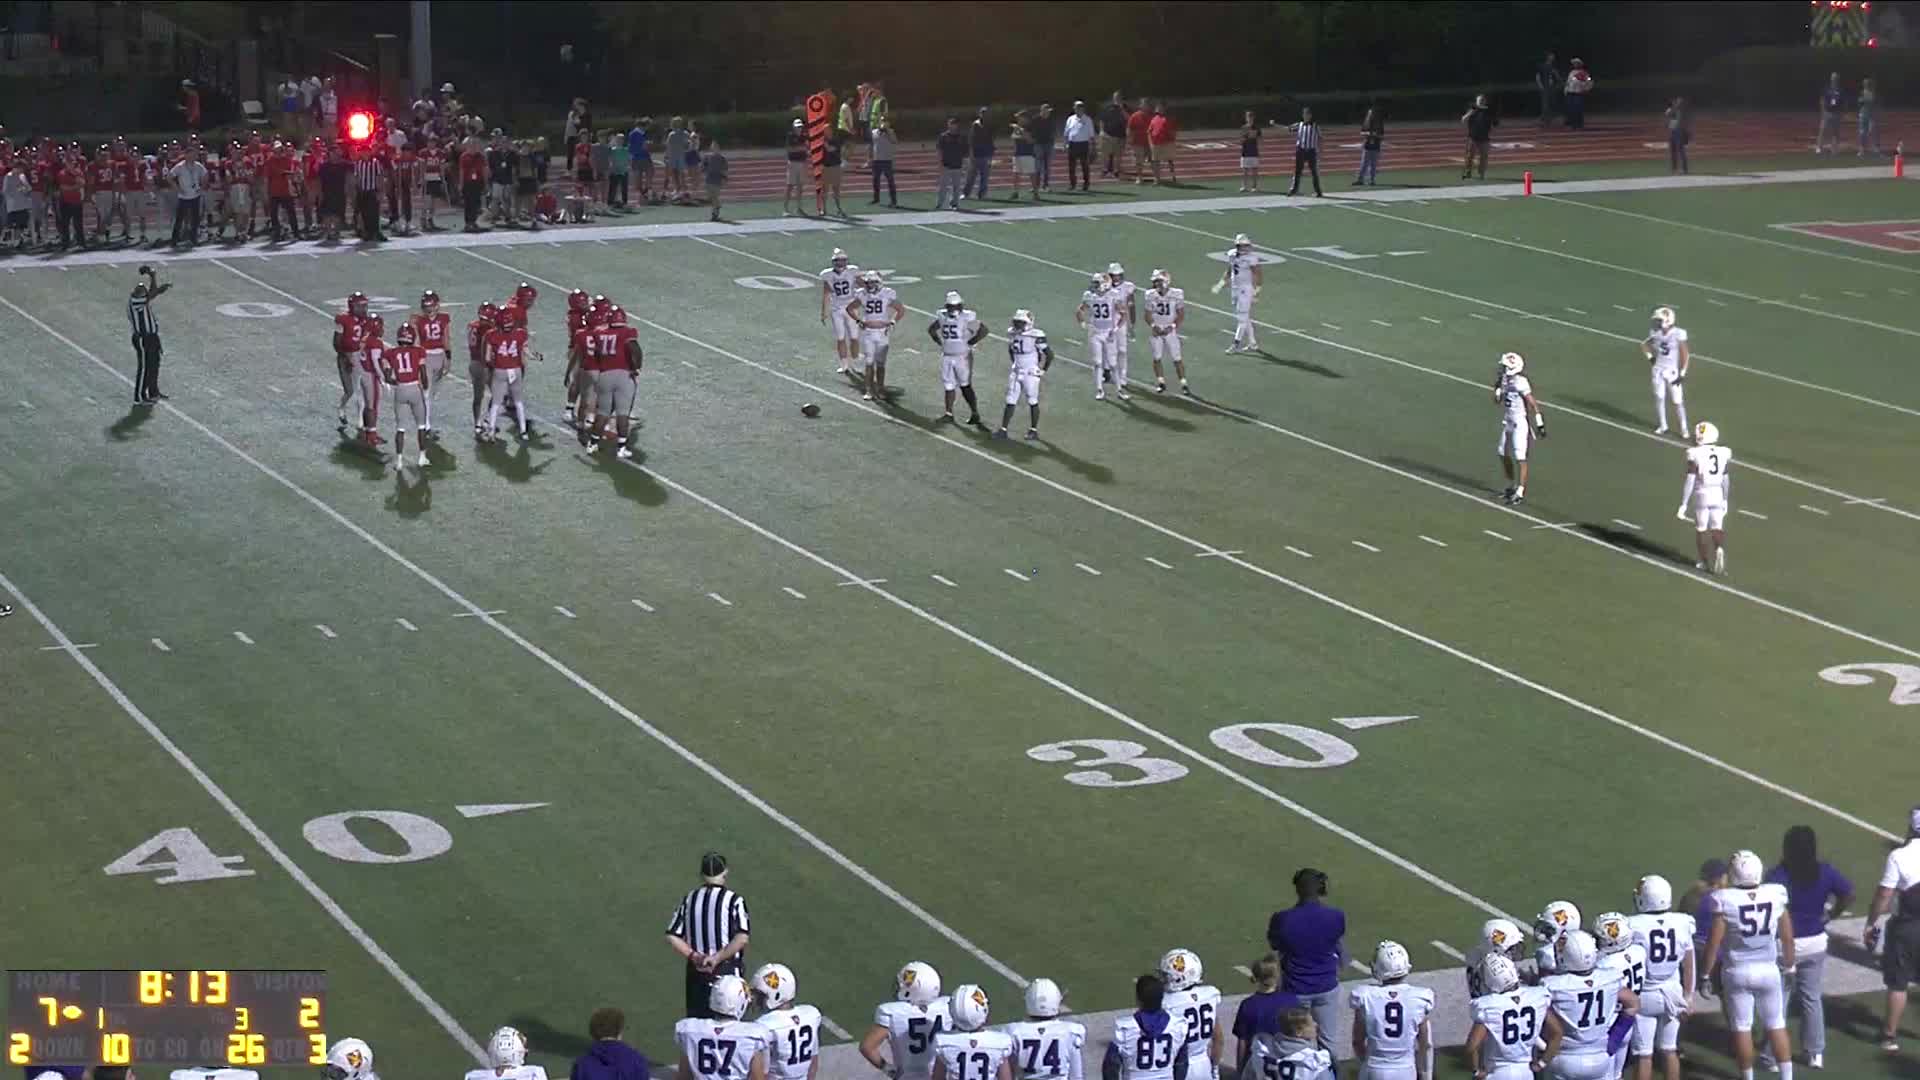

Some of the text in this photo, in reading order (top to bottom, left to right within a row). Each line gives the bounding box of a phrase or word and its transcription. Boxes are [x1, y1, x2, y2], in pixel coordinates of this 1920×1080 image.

[866, 300, 883, 314] 58
[1093, 303, 1110, 319] 33
[1156, 303, 1171, 317] 31
[424, 323, 441, 340] 12
[599, 335, 618, 355] 77
[942, 324, 959, 340] 55
[396, 351, 413, 374] 11
[496, 341, 519, 358] 44
[1708, 454, 1719, 476] 3
[1738, 902, 1773, 938] 57
[1649, 928, 1678, 964] 61
[1184, 1003, 1214, 1044] 26
[1384, 1002, 1404, 1039] 9
[1577, 989, 1606, 1028] 71
[1502, 1006, 1536, 1045] 63
[697, 1039, 737, 1076] 67
[787, 1025, 814, 1066] 12
[1022, 1039, 1061, 1076] 74
[1136, 1033, 1173, 1070] 83
[956, 1051, 990, 1080] 13
